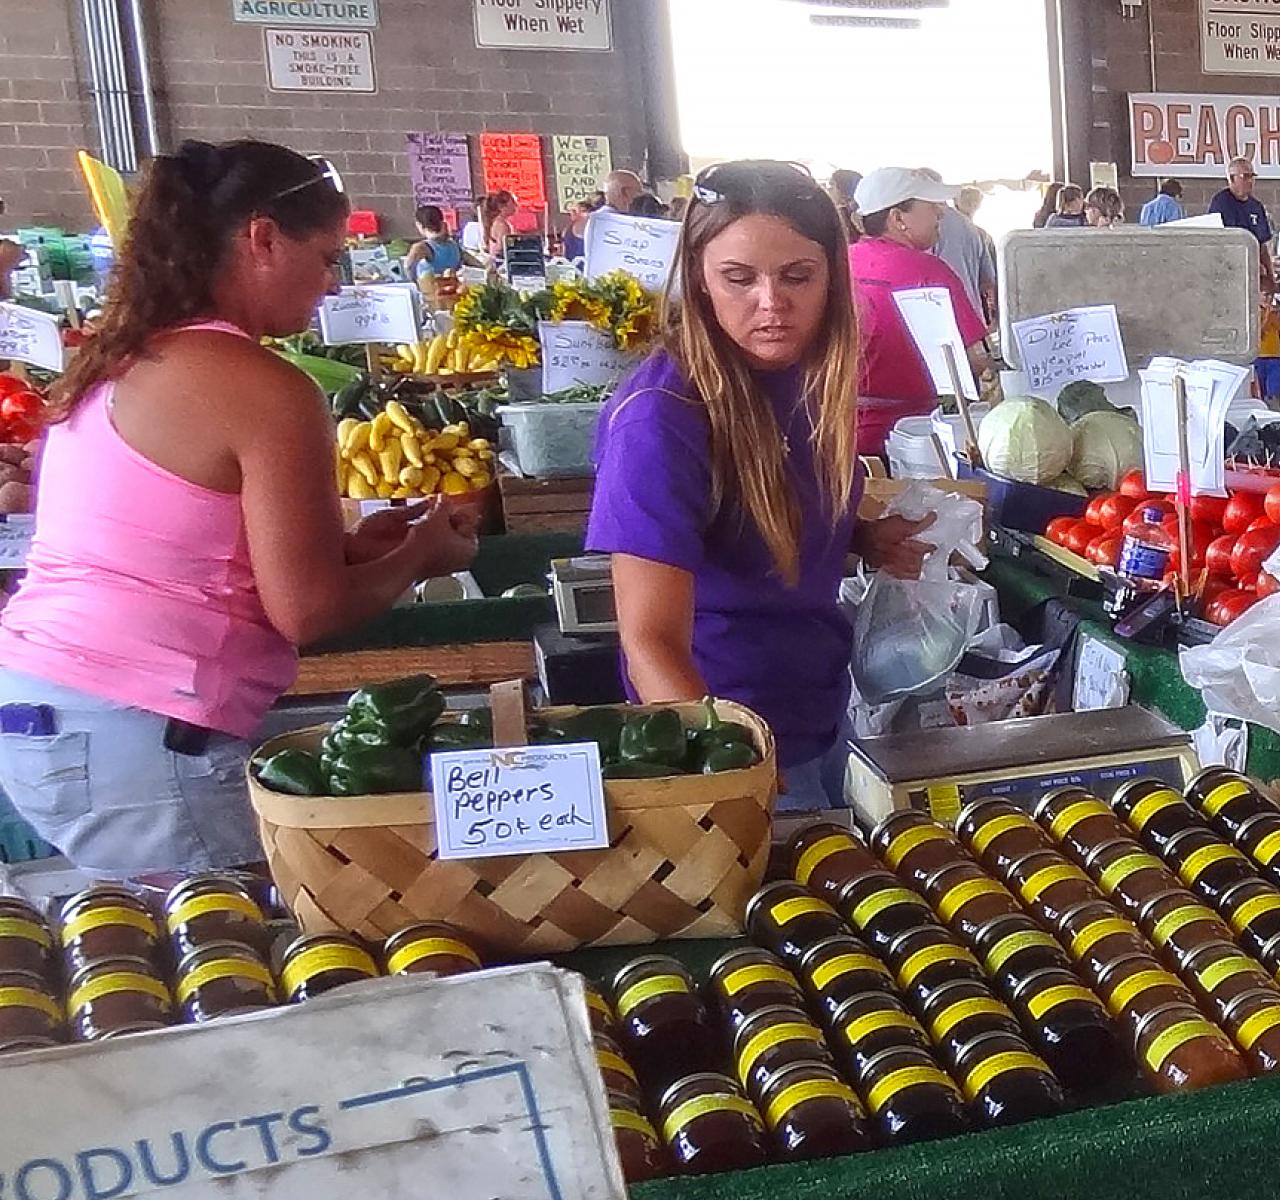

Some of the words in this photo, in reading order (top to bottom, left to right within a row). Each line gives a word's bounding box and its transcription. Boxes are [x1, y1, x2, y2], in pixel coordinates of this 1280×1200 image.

[241, 1, 369, 19] AGRICULTURE
[504, 14, 549, 32] When
[557, 16, 585, 34] Wet
[1207, 21, 1241, 38] Floor
[275, 34, 294, 46] NO
[301, 35, 362, 48] SMOKING
[293, 51, 317, 61] THIS
[326, 51, 338, 61] IS
[348, 52, 355, 61] A
[1223, 43, 1259, 60] When
[288, 63, 362, 75] SMOKE-FREE
[300, 75, 353, 87] BUILDING
[556, 136, 582, 150] We
[557, 152, 606, 166] Accept
[559, 164, 602, 175] Credit
[571, 176, 596, 186] AND
[1022, 325, 1075, 345] Dixie
[489, 751, 526, 768] NC
[448, 766, 500, 793] Bell
[539, 803, 593, 831] each
[0, 1105, 332, 1200] ODUCTS
